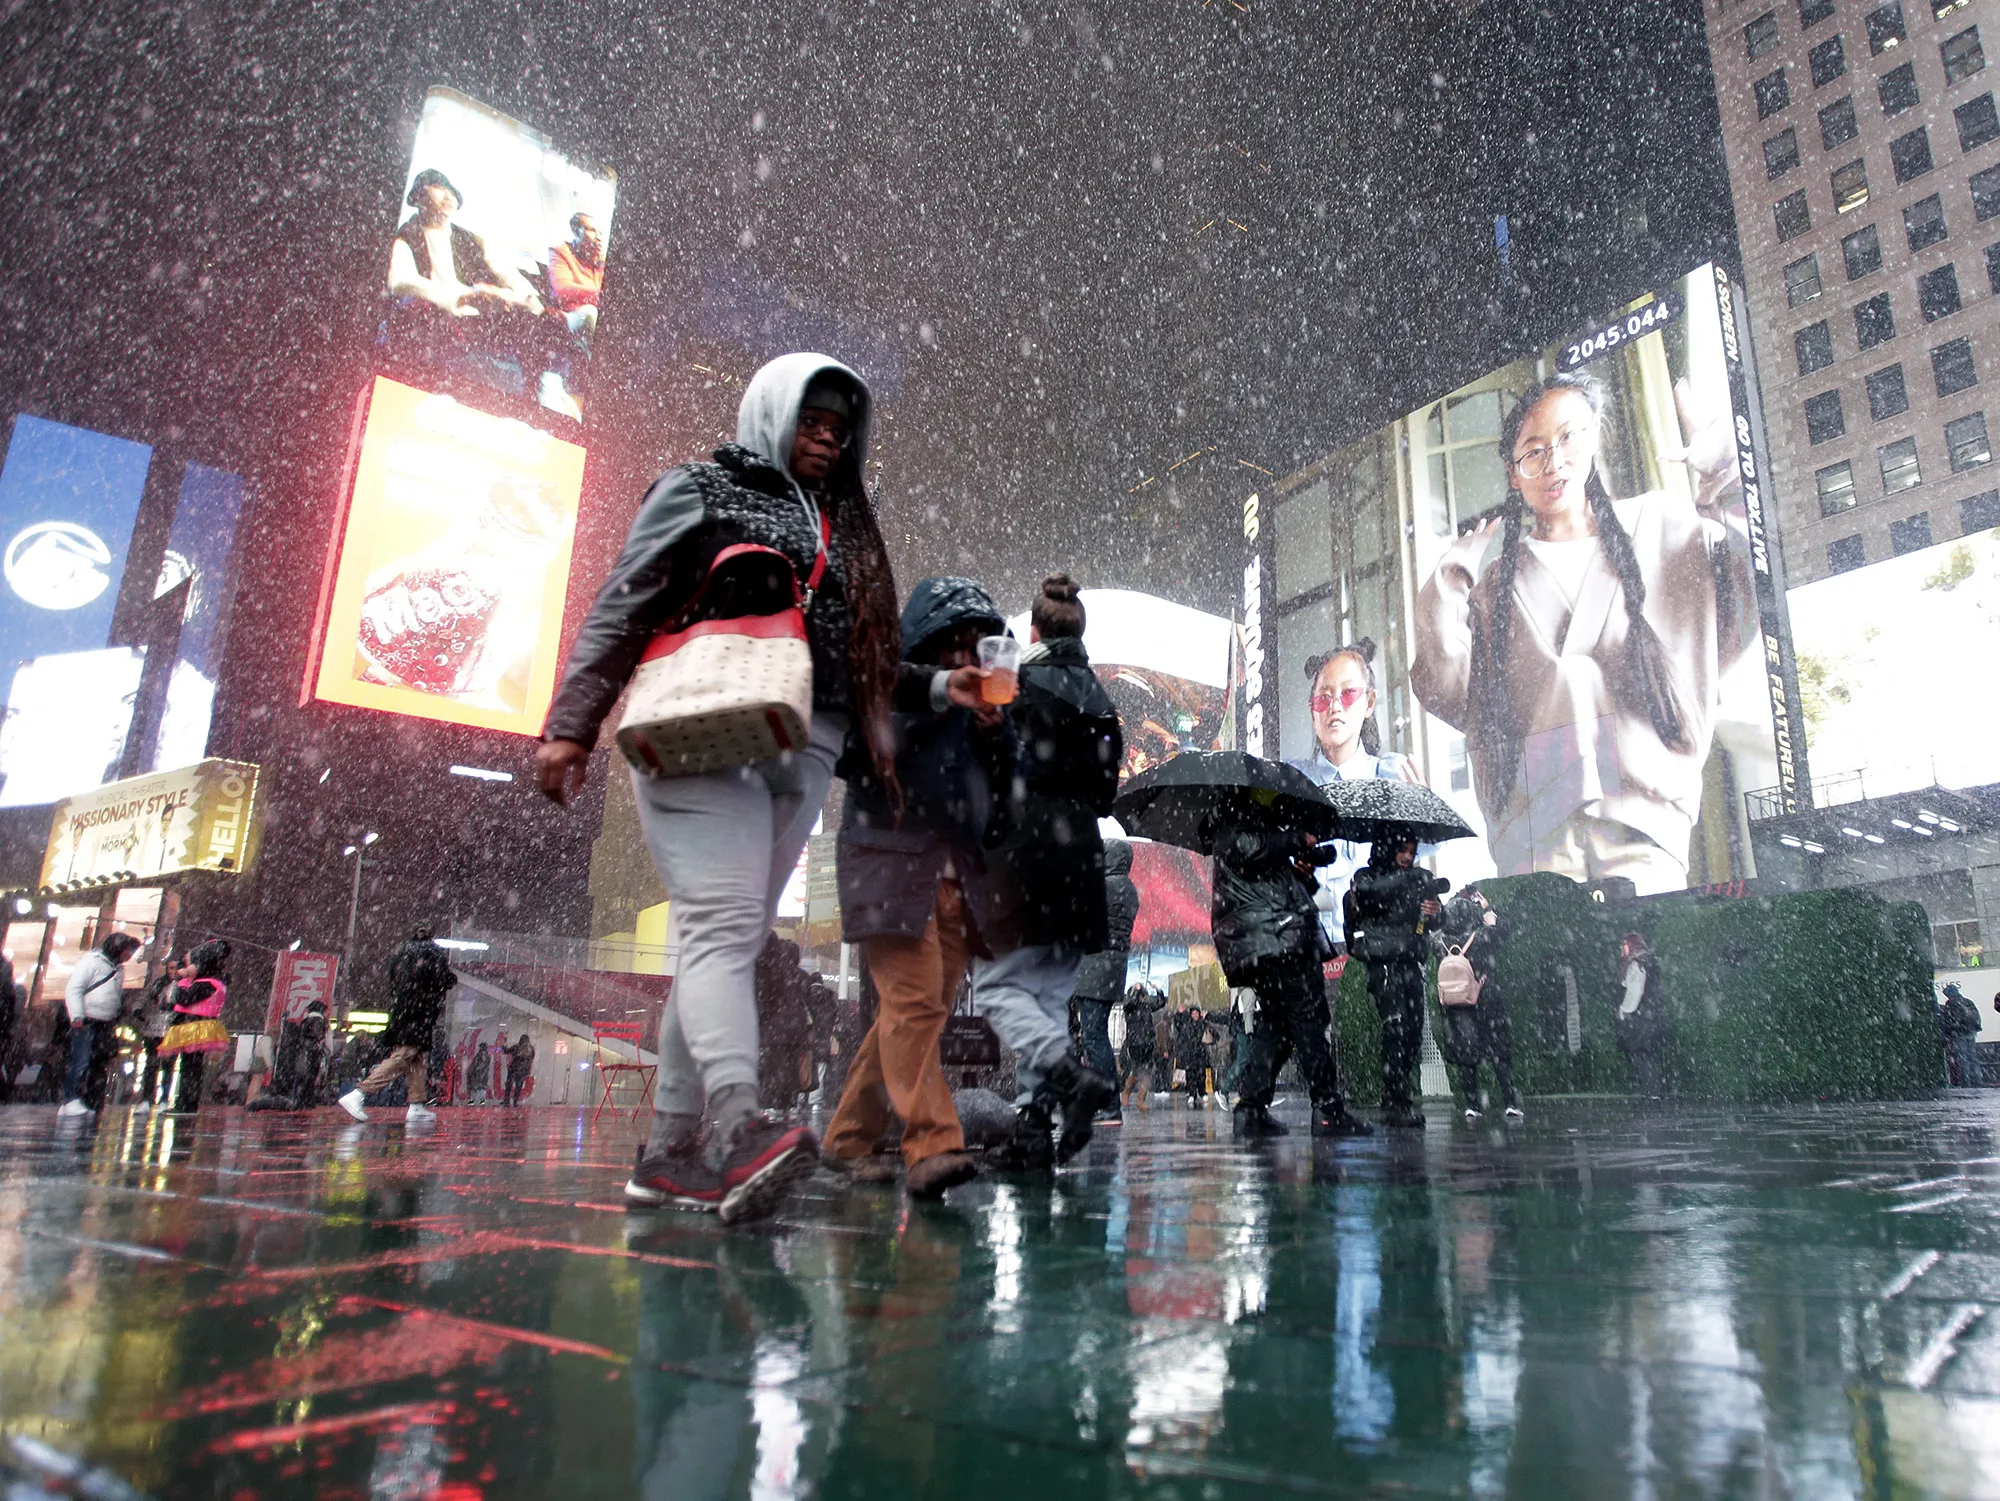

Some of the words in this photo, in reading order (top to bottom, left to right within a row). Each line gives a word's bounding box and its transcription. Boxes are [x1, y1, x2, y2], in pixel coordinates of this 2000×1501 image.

[1567, 301, 1669, 365] 2045.044
[1717, 284, 1740, 363] SCREEN
[1735, 414, 1751, 447] GO
[1740, 450, 1756, 479] TO
[1744, 483, 1769, 576] TSX.LIVE
[1243, 553, 1265, 704] SQUARE
[1765, 633, 1782, 667] BE
[69, 799, 146, 832] MISSIONARY
[145, 788, 189, 816] STYLE
[132, 780, 167, 796] THEATER
[286, 958, 328, 1020] tkts
